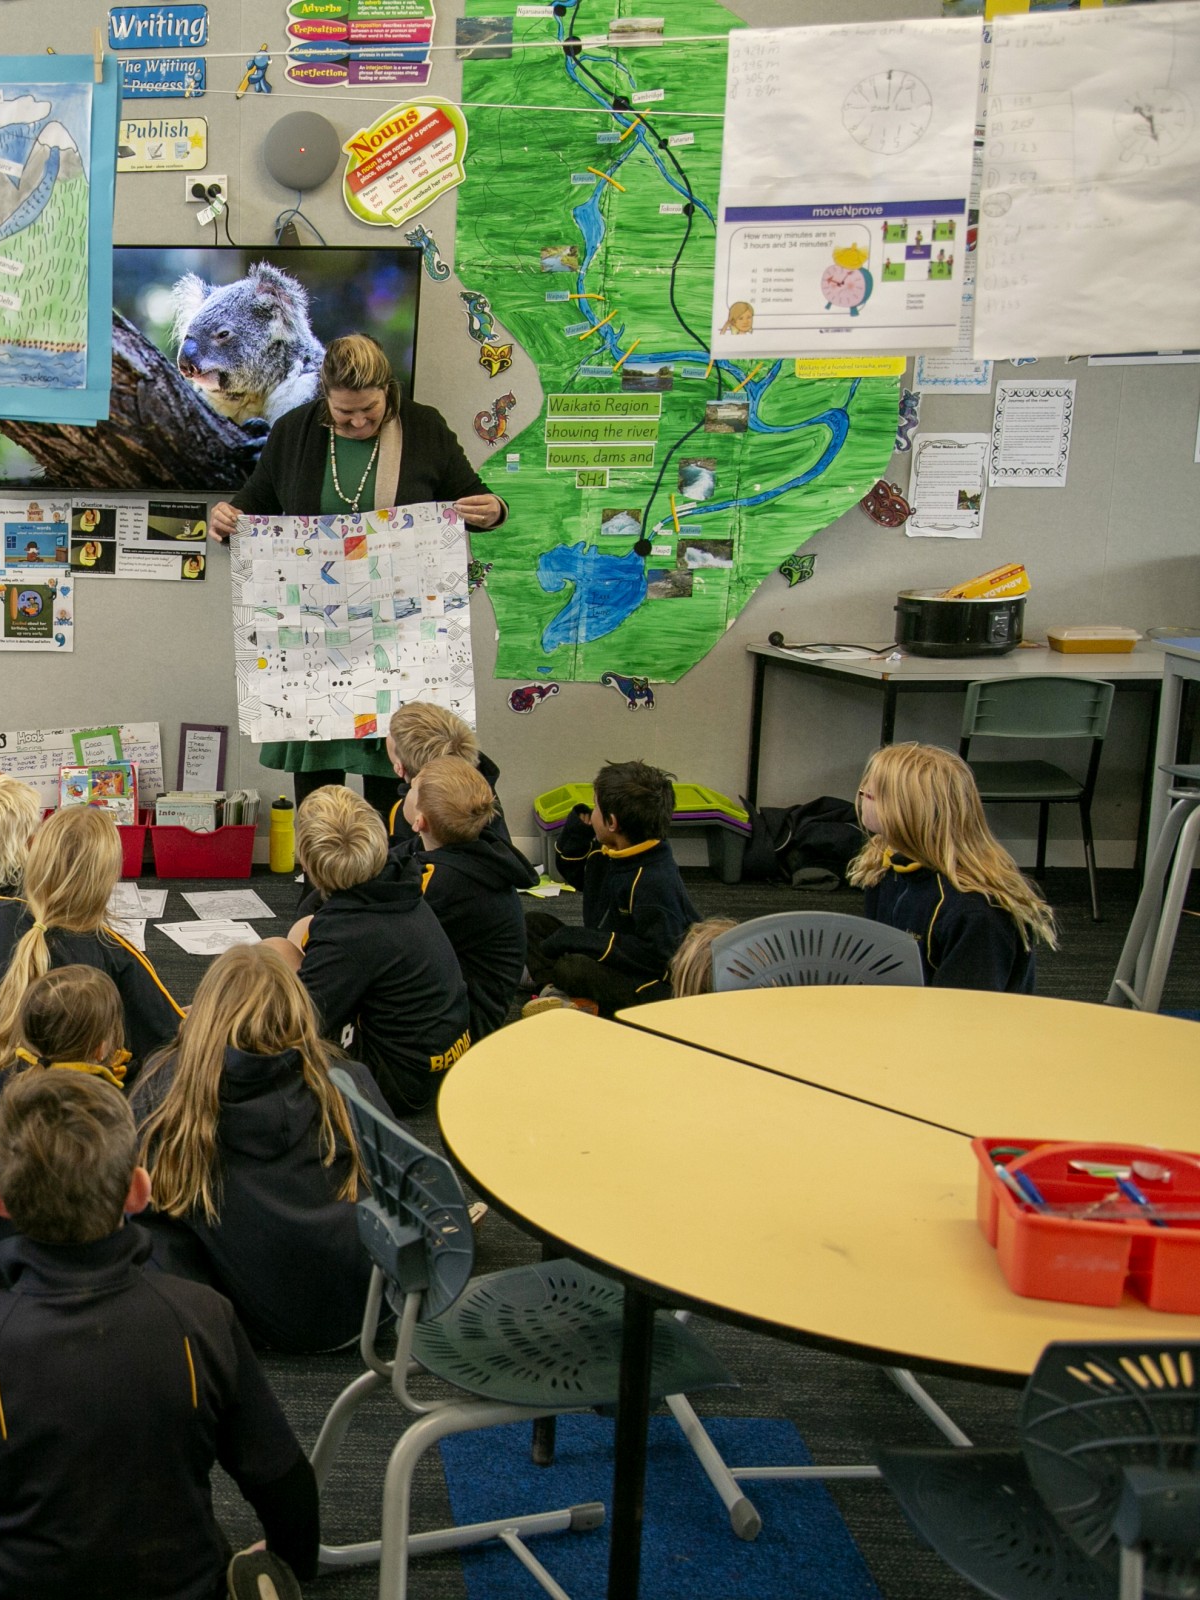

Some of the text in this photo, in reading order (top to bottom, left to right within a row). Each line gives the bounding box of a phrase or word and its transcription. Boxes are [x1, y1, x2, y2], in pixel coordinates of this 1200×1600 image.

[302, 4, 341, 13] Adverbs
[111, 13, 205, 44] Writing
[293, 24, 346, 34] Prepositions
[118, 59, 197, 75] The Writing
[292, 68, 347, 77] Interjections
[132, 79, 183, 92] Process
[632, 90, 663, 102] Cambridge
[126, 120, 188, 139] Publish
[349, 110, 418, 162] Nouns
[812, 205, 883, 218] moveNprove
[743, 232, 759, 240] How
[761, 232, 782, 242] many
[784, 230, 810, 239] minutes
[743, 241, 748, 249] 3
[749, 241, 768, 249] hours
[770, 241, 780, 249] and
[794, 240, 833, 248] minutes?
[21, 373, 59, 383] Jackson
[550, 398, 648, 415] Waikatō Region
[546, 424, 657, 442] showing the river,
[549, 448, 653, 465] towns, dams and
[578, 473, 605, 486] SH1
[983, 577, 1022, 597] ARMADA
[16, 730, 45, 745] Hook
[179, 815, 212, 826] Wild
[429, 1028, 471, 1072] BENDA
